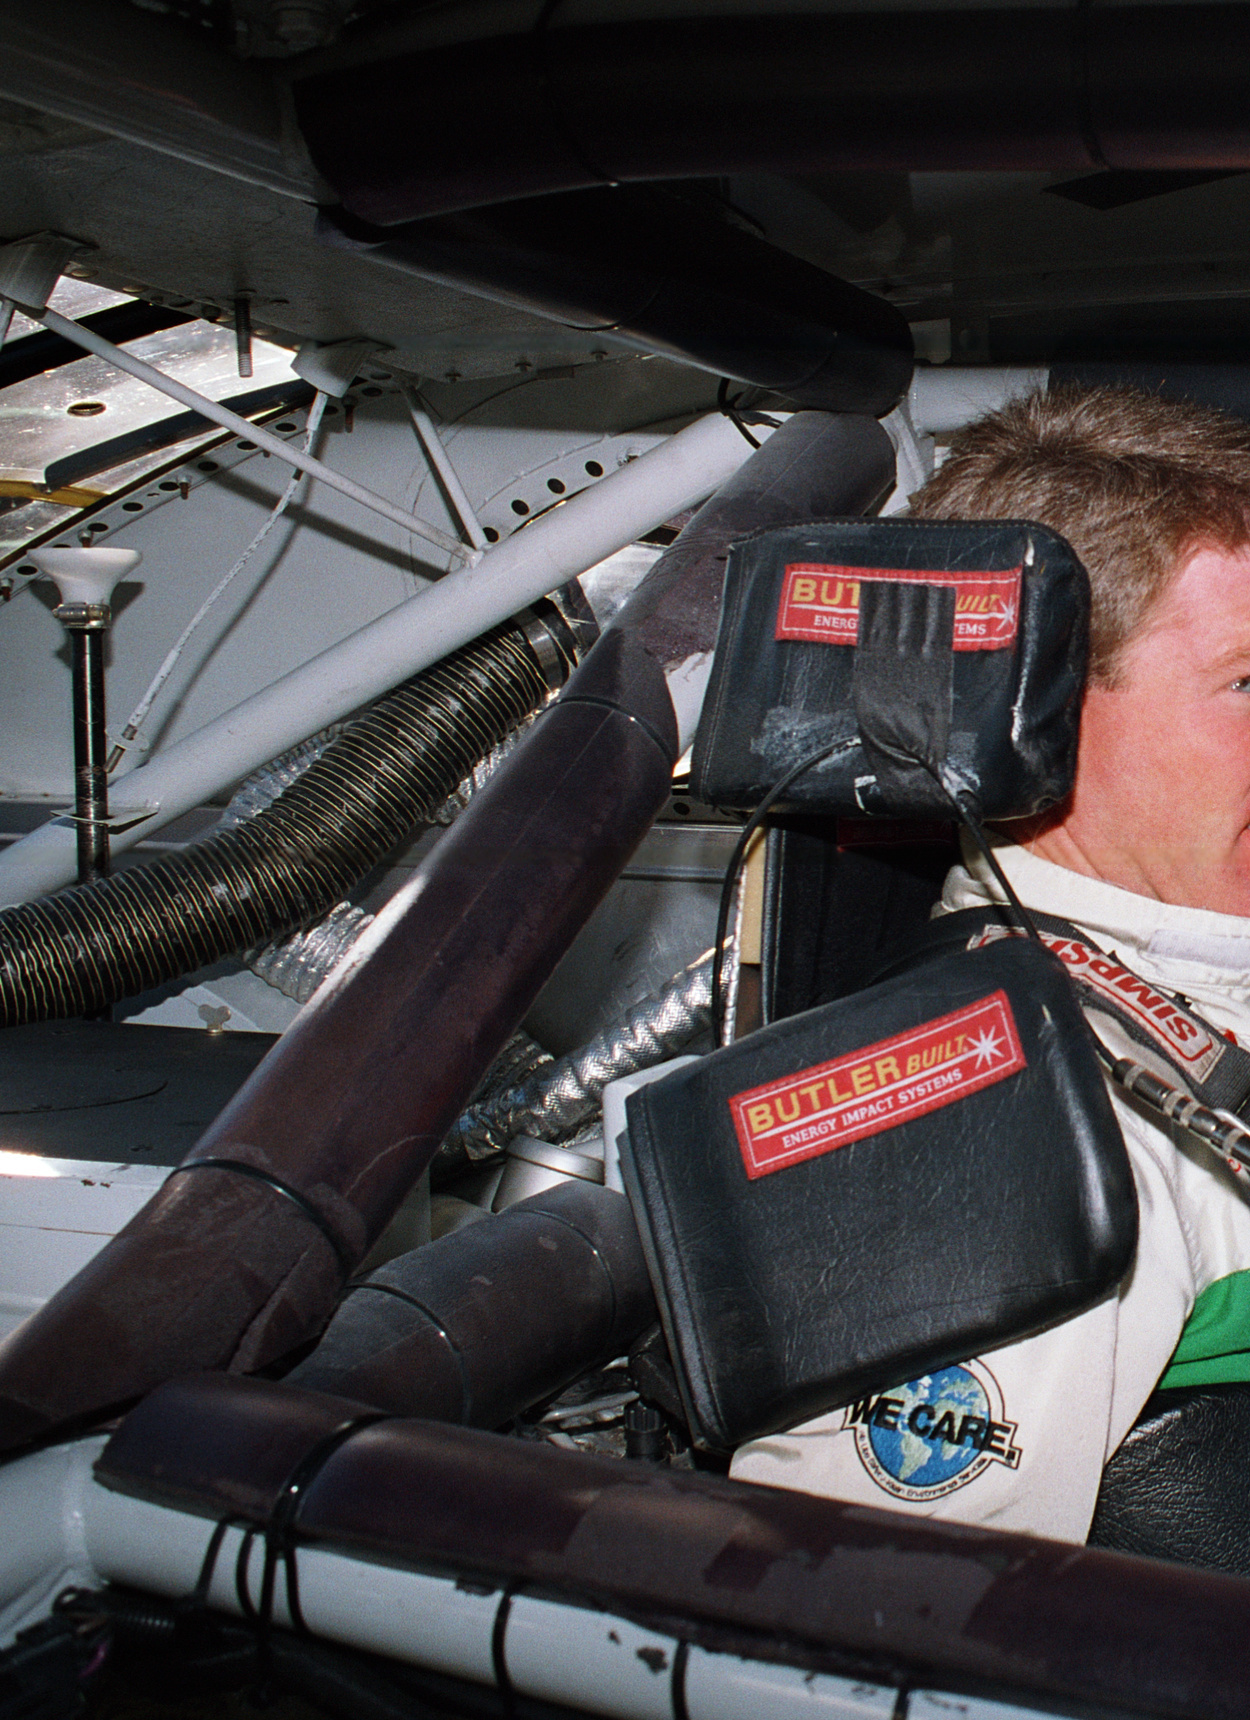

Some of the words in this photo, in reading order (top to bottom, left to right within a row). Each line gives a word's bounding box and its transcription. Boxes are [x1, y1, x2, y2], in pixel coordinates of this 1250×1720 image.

[792, 578, 860, 606] BUT
[956, 594, 1001, 612] UILT
[813, 615, 858, 630] ENERG
[1041, 939, 1198, 1042] SIMPS
[747, 1055, 901, 1134] BUTLER
[906, 1034, 967, 1076] BUILT
[782, 1118, 837, 1149] ENERGY
[842, 1098, 894, 1127] IMPACT
[899, 1068, 963, 1104] SYSTEMS
[849, 1397, 905, 1431] WE
